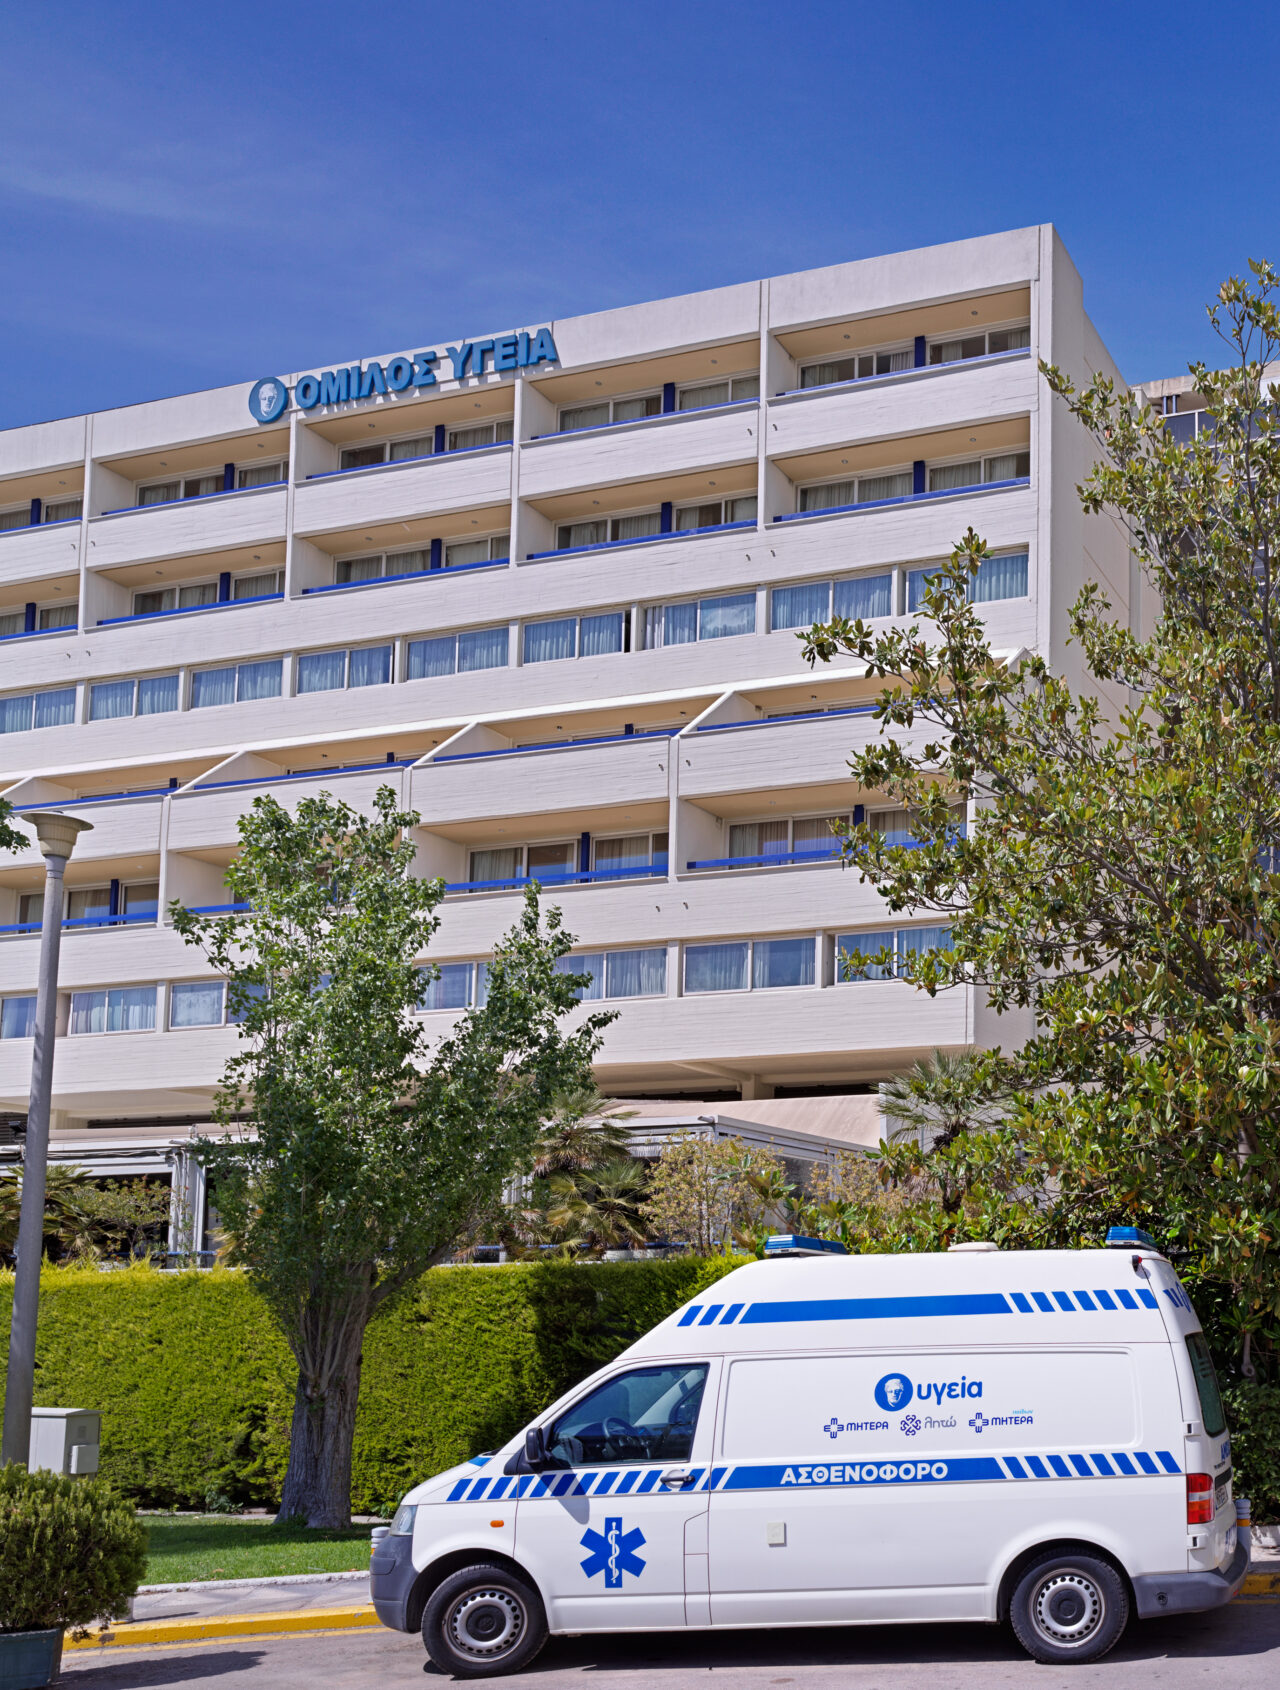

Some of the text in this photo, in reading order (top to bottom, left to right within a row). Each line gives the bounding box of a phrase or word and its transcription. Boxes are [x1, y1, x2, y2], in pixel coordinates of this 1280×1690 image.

[295, 328, 558, 410] ΟΜΙΛΟΣ ΥΓΕΙΑ
[916, 1375, 983, 1406] υγεία
[846, 1421, 889, 1432] ΜΗΤΕΡΑ
[924, 1415, 957, 1429] λητώ
[991, 1415, 1034, 1426] ΜΗΤΕΡΑ
[780, 1462, 949, 1485] ΑΣΘΕΝΟΦΟΡΟ
